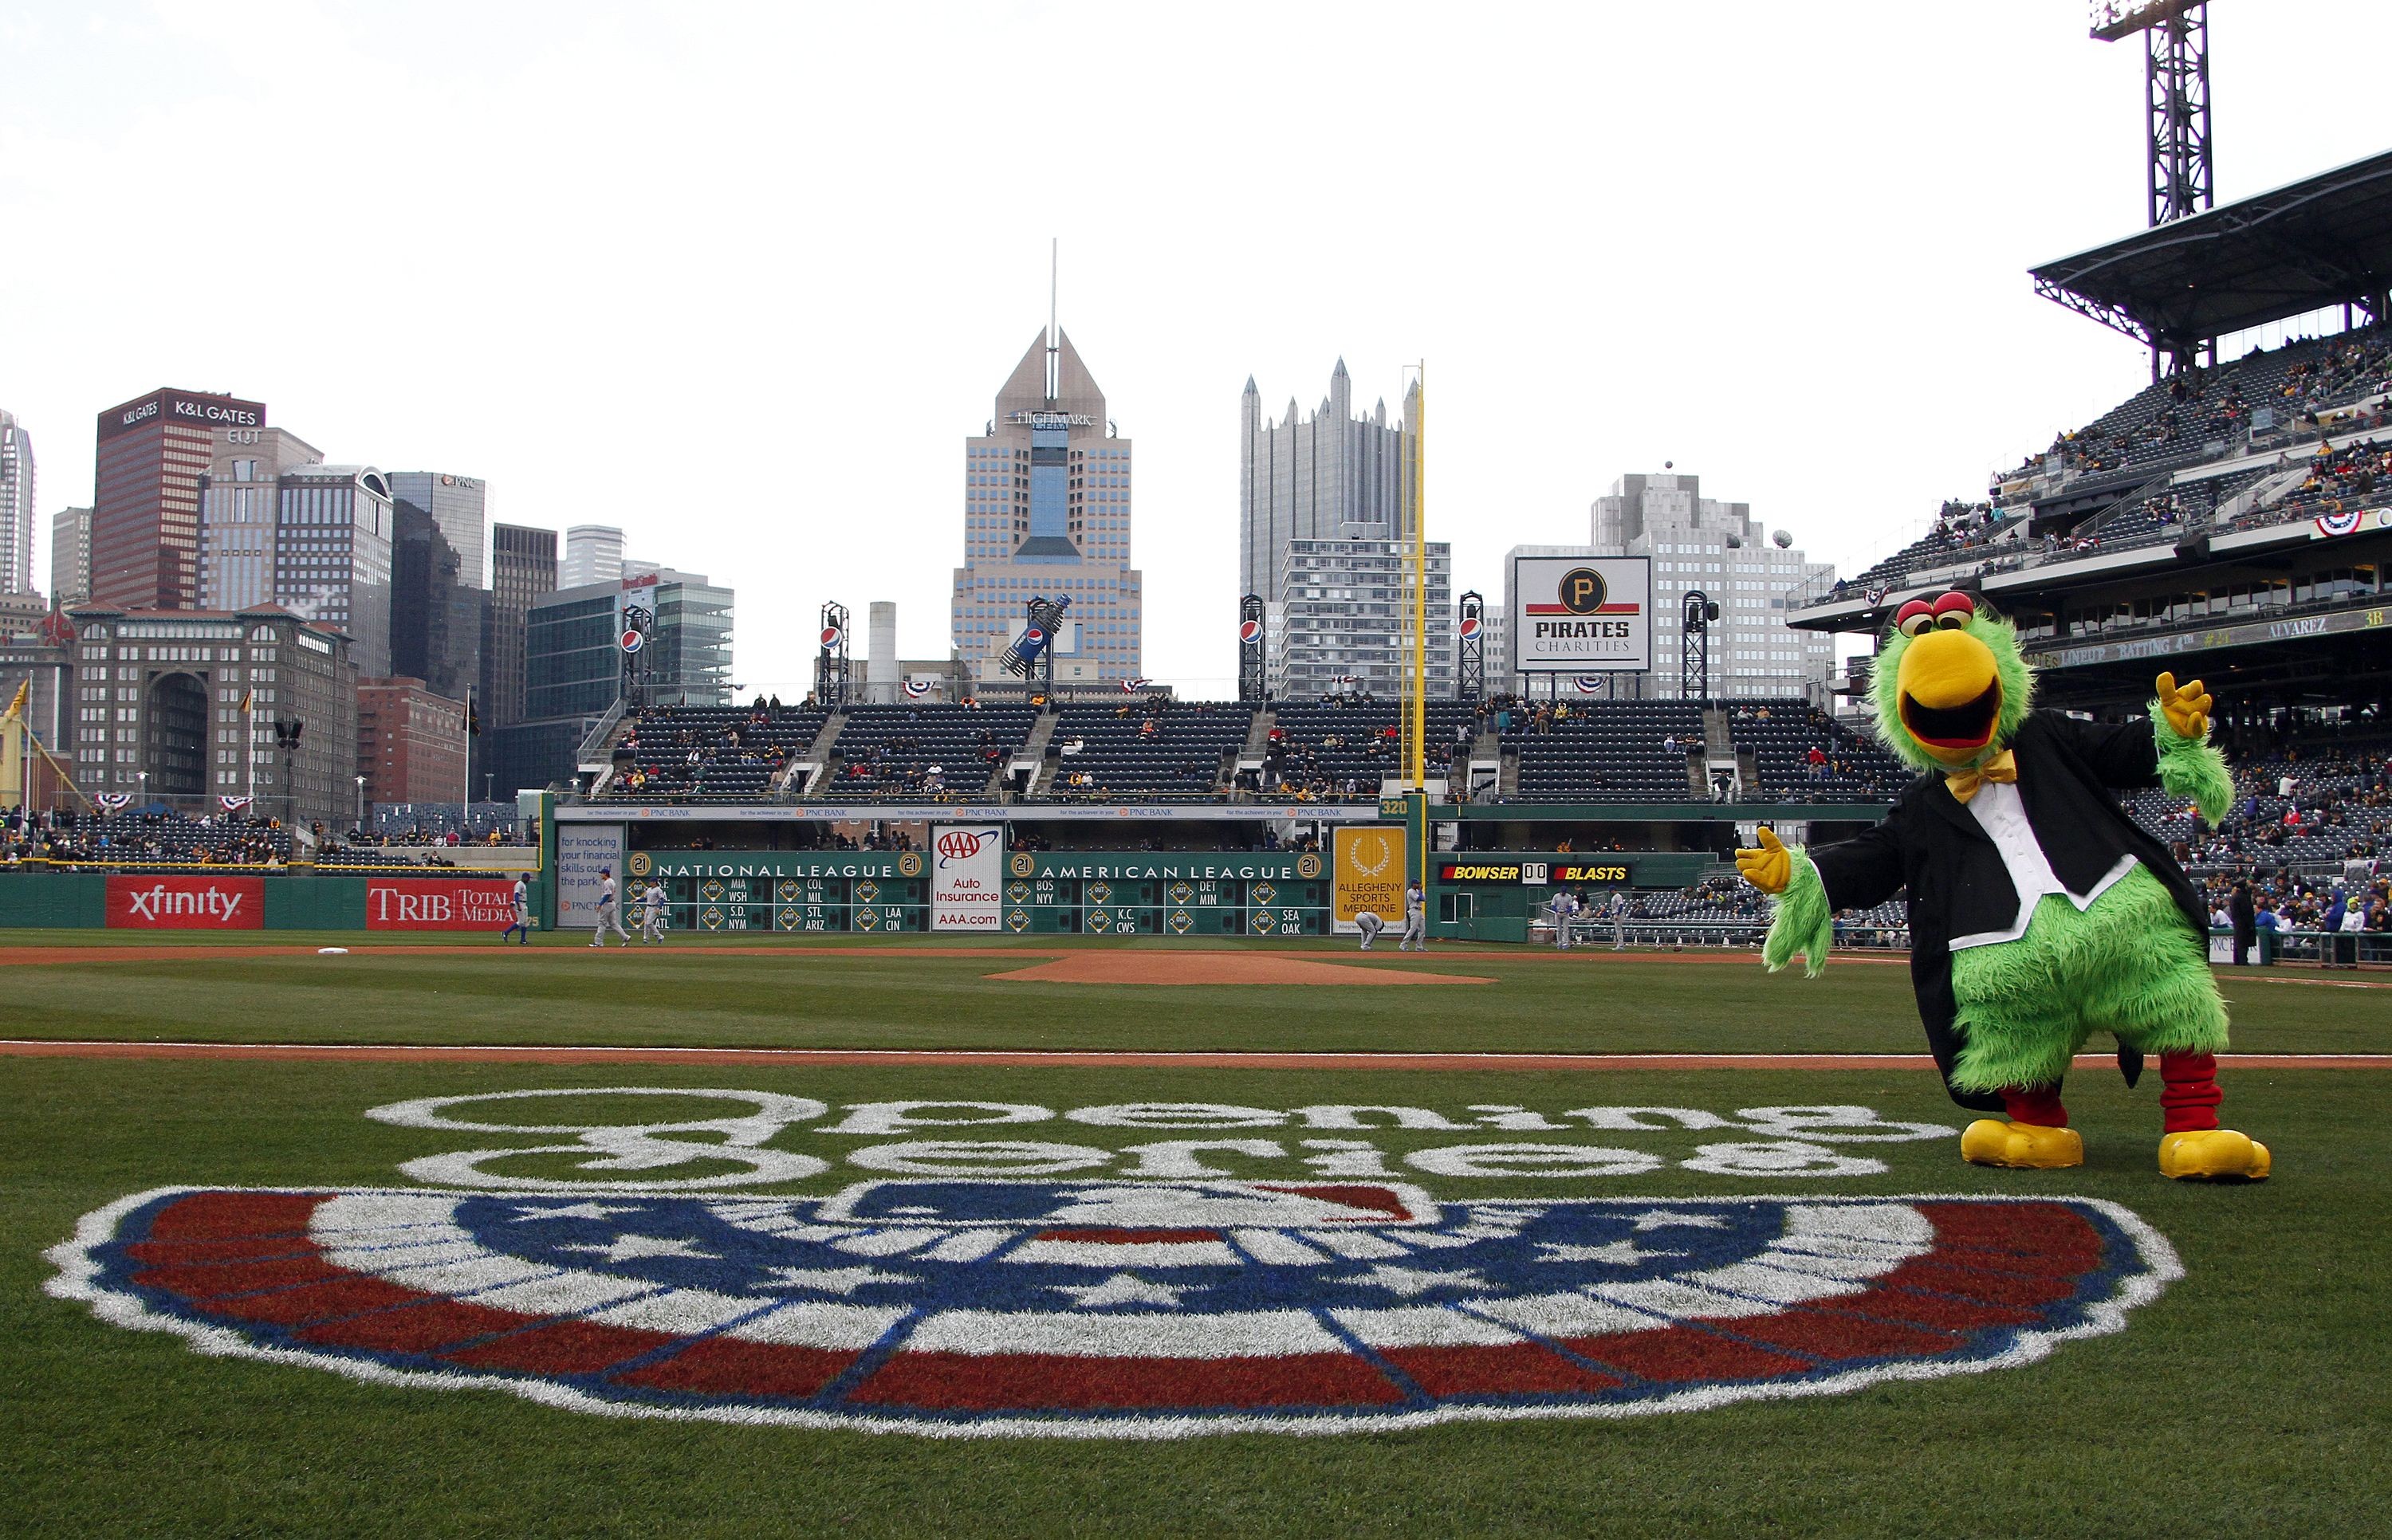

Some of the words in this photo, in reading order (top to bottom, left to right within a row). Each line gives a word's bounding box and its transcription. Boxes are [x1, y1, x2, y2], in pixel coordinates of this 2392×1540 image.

[123, 407, 136, 425] K&L
[136, 402, 158, 420] GATES
[175, 401, 204, 417] K&L
[207, 406, 256, 426] GATES
[1017, 411, 1092, 426] HIGHMARK
[228, 429, 262, 444] EQT
[1573, 577, 1594, 606] P
[1536, 622, 1629, 638] PIRATES
[2268, 618, 2327, 638] ALVAREZ
[1536, 640, 1629, 652] CHARITIES
[2060, 647, 2106, 666] LINEUP
[2117, 638, 2170, 659] BATTING
[1381, 800, 1408, 814] 320
[561, 837, 574, 847] for
[576, 837, 616, 849] knocking
[941, 831, 978, 858] AAA
[561, 852, 581, 862] your
[583, 851, 620, 859] financial
[561, 863, 584, 873] skills
[586, 864, 601, 873] out
[634, 858, 647, 871] 21
[903, 858, 916, 871] 21
[1015, 858, 1029, 872] 21
[1302, 858, 1316, 873] 21
[659, 865, 785, 877] NATIONAL
[797, 865, 891, 877] LEAGUE
[1041, 866, 1178, 878] AMERICAN
[1190, 866, 1291, 878] LEAGUE
[1453, 866, 1519, 879] BOWSER
[1565, 866, 1627, 880] BLASTS
[561, 877, 576, 886] the
[577, 877, 600, 889] park.
[731, 878, 746, 890] MIA
[807, 879, 823, 890] COL
[953, 878, 980, 889] Auto
[1037, 880, 1053, 891] BOS
[1199, 881, 1217, 892] DET
[1339, 883, 1402, 892] ALLEGHENY
[129, 884, 242, 920] xfinity
[458, 889, 511, 906] TOTAL
[729, 892, 747, 902] WSH
[808, 893, 823, 903] MIL
[936, 891, 999, 902] Insurance
[1037, 894, 1053, 904] NYY
[1199, 894, 1217, 906] MIN
[1350, 894, 1390, 902] SPORTS
[369, 888, 451, 921] TRIB
[572, 902, 595, 910] PNC
[1344, 904, 1396, 913] MEDICINE
[462, 906, 514, 921] MEDIA
[659, 906, 671, 916] HIL
[730, 906, 746, 917] S.D.
[807, 906, 822, 917] STL
[885, 907, 902, 917] LAA
[1118, 909, 1134, 920] K.C.
[1282, 909, 1300, 921] SEA
[525, 916, 540, 927] 75
[655, 918, 670, 929] ATL
[729, 919, 747, 929] NYM
[805, 920, 824, 930] ARIZ
[938, 914, 997, 925] AAA.com
[886, 921, 900, 931] CIN
[1116, 922, 1135, 933] CWS
[1281, 923, 1300, 934] OAK
[364, 1086, 1959, 1144] Opening
